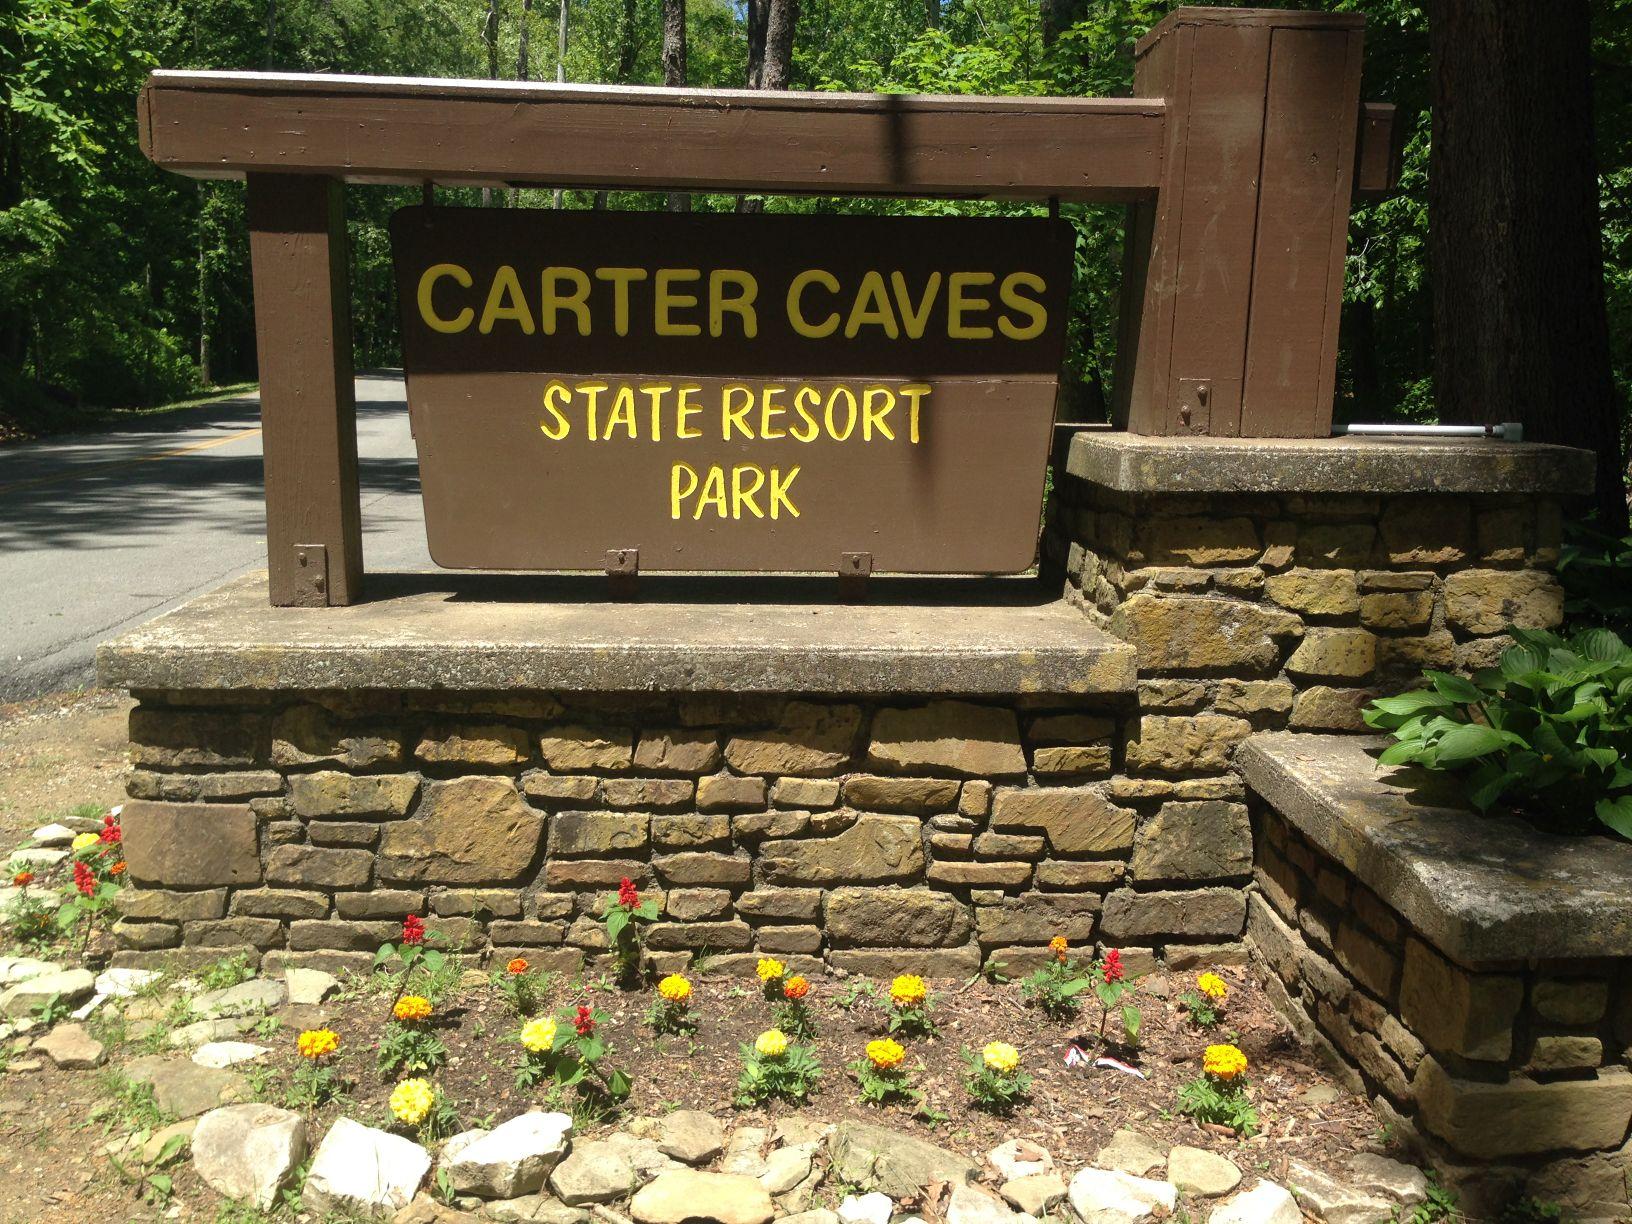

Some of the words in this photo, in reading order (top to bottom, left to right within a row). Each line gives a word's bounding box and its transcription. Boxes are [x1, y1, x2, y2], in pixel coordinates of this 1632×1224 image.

[416, 263, 759, 338] CARTER
[785, 268, 1049, 341] CAVES
[539, 379, 704, 442] STATE
[721, 382, 932, 444] RESORT
[670, 460, 802, 521] PARK
